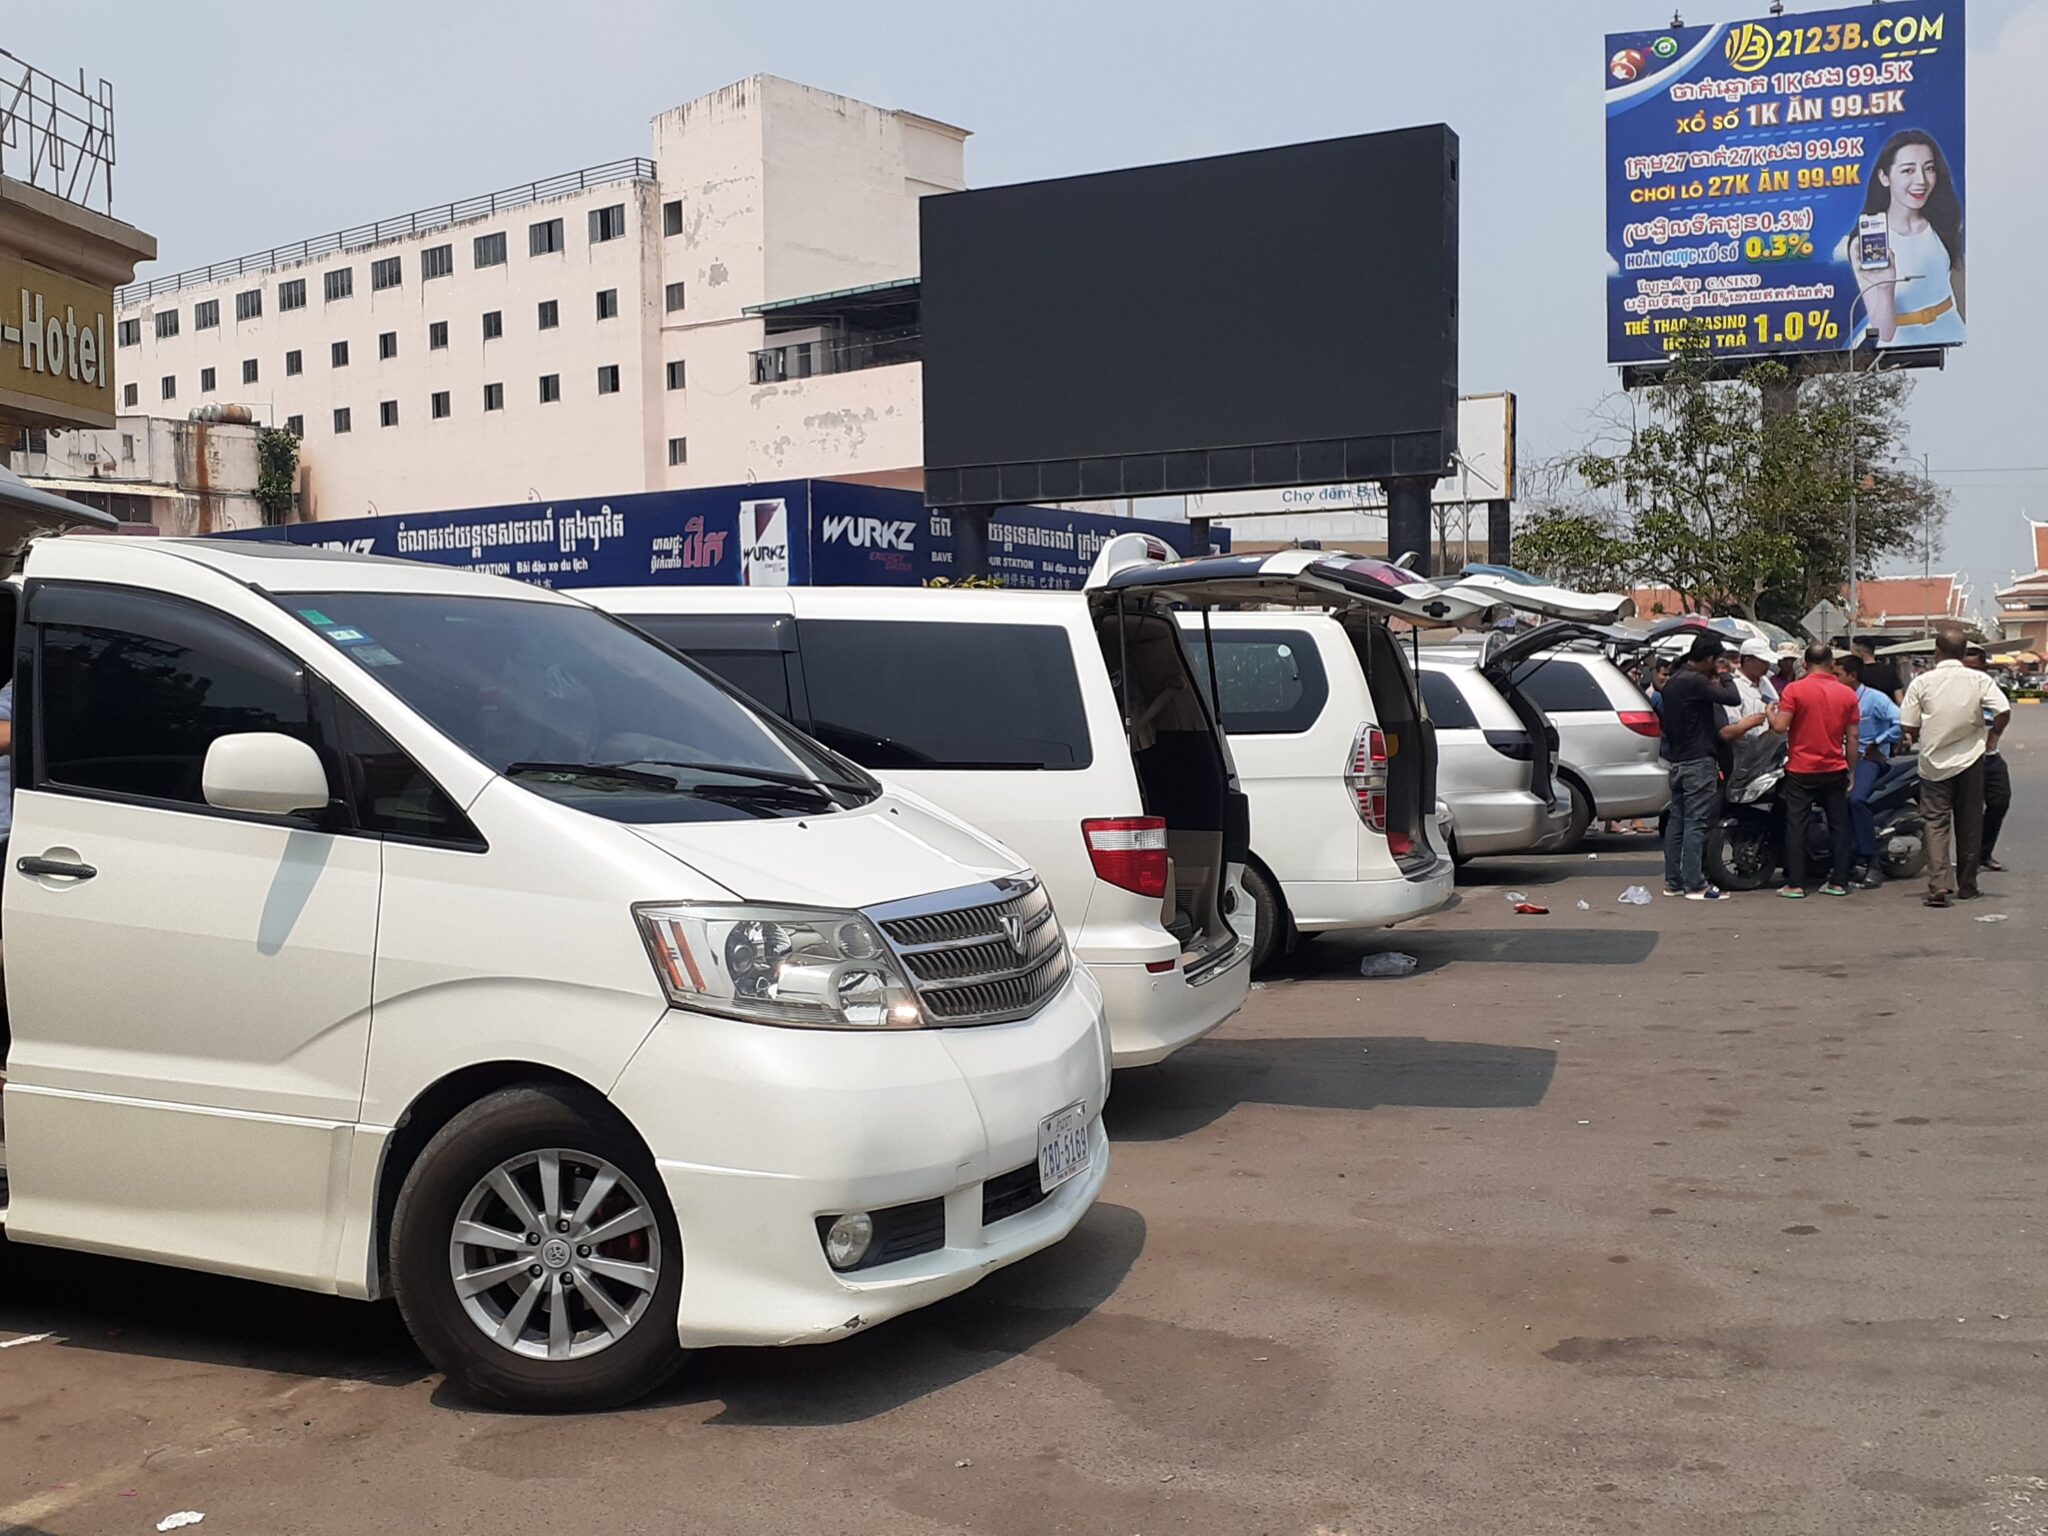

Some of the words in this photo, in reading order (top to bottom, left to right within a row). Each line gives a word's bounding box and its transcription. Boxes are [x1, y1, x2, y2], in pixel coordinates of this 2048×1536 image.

[1773, 13, 1945, 58] 2123B.COM
[1846, 61, 1915, 87] 99.5K
[1746, 101, 1779, 126] 1K
[1786, 96, 1823, 123] ĂN
[1830, 89, 1905, 118] 99.5K
[1804, 137, 1864, 161] 99.9K
[1630, 183, 1676, 203] CHƠI
[1681, 180, 1704, 199] LÔ
[1708, 174, 1750, 197] 27K
[1757, 168, 1789, 193] ĂN
[1797, 164, 1860, 189] 99.9K
[1625, 248, 1662, 269] HOÀN
[1662, 249, 1698, 268] CƯỢC
[1699, 242, 1719, 264] XỔ
[1719, 241, 1740, 261] SỐ
[1744, 233, 1815, 262] 0.3%
[1705, 273, 1761, 290] CASINO
[1624, 316, 1650, 336] THỂ
[1753, 309, 1839, 343] 1.0%
[1715, 330, 1747, 348] TRẢ
[1282, 490, 1315, 503] Chợ
[822, 515, 917, 551] WURKZ
[743, 545, 786, 561] WURKZ
[931, 551, 953, 563] BAVE
[1003, 558, 1034, 570] STATION
[1068, 566, 1077, 574] xe
[1078, 565, 1088, 575] du
[474, 562, 510, 576] STATION
[532, 560, 547, 575] đậu
[548, 563, 559, 572] xe
[560, 559, 572, 571] du
[573, 558, 588, 573] lịch
